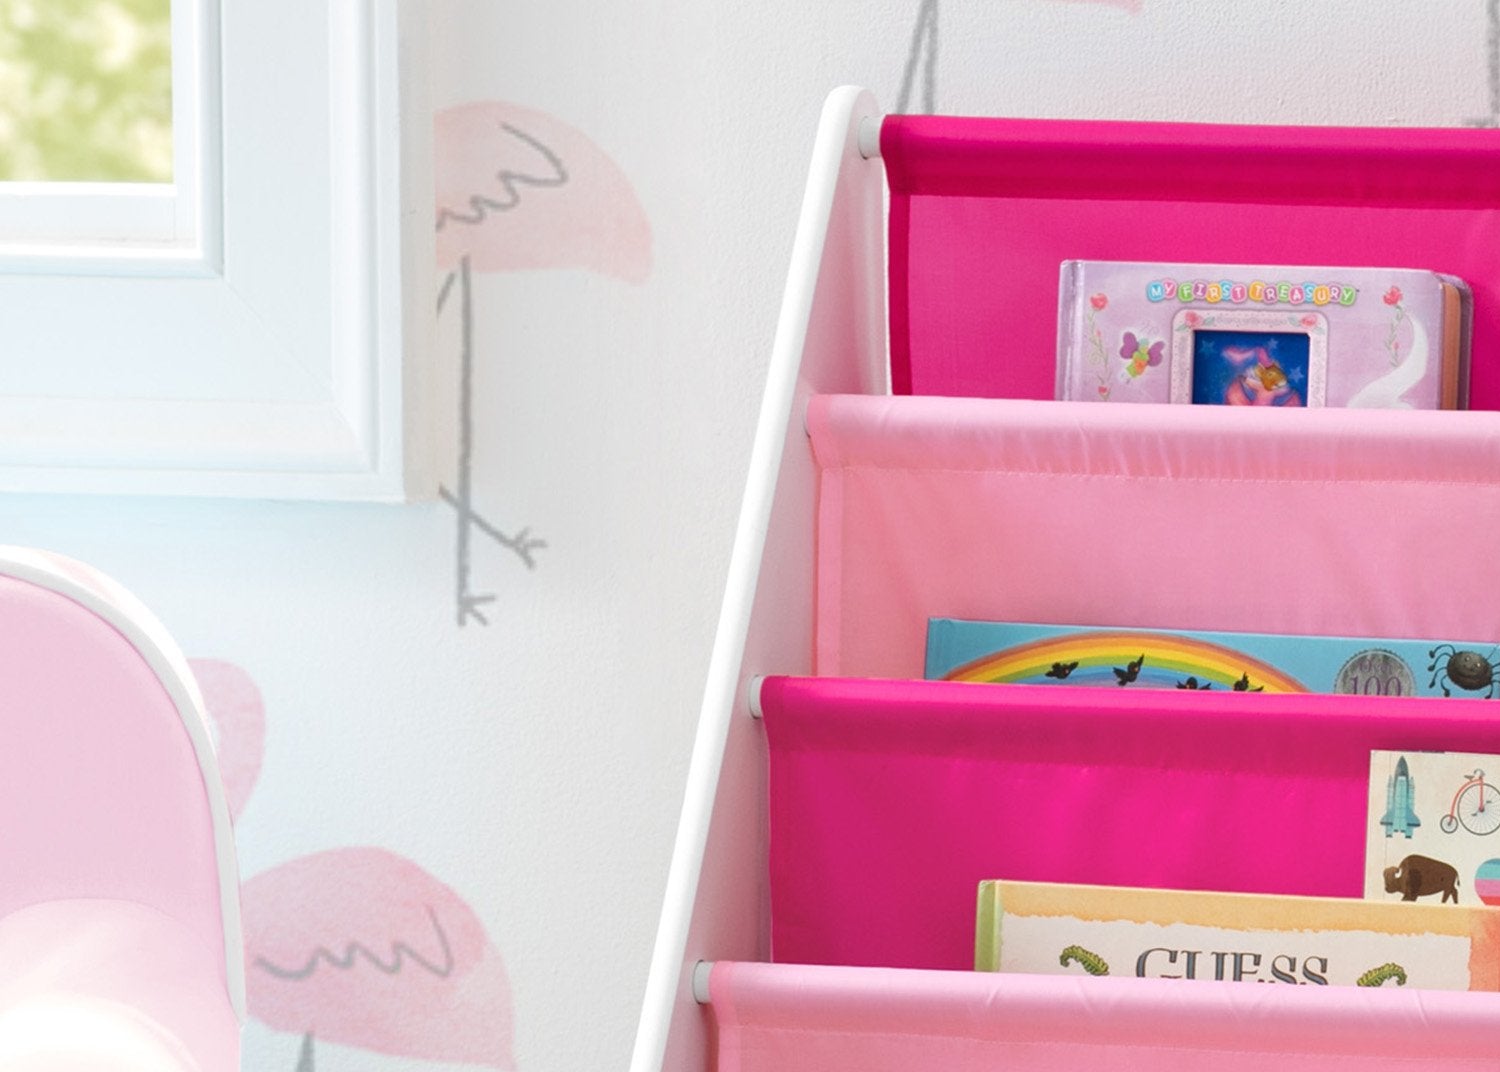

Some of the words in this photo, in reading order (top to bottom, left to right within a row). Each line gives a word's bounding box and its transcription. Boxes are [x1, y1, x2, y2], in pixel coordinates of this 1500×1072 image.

[1151, 282, 1174, 298] MY
[1182, 283, 1242, 299] FIRST
[1254, 284, 1355, 302] TREASURY
[1350, 675, 1402, 696] 100
[1135, 947, 1329, 987] GUESS
